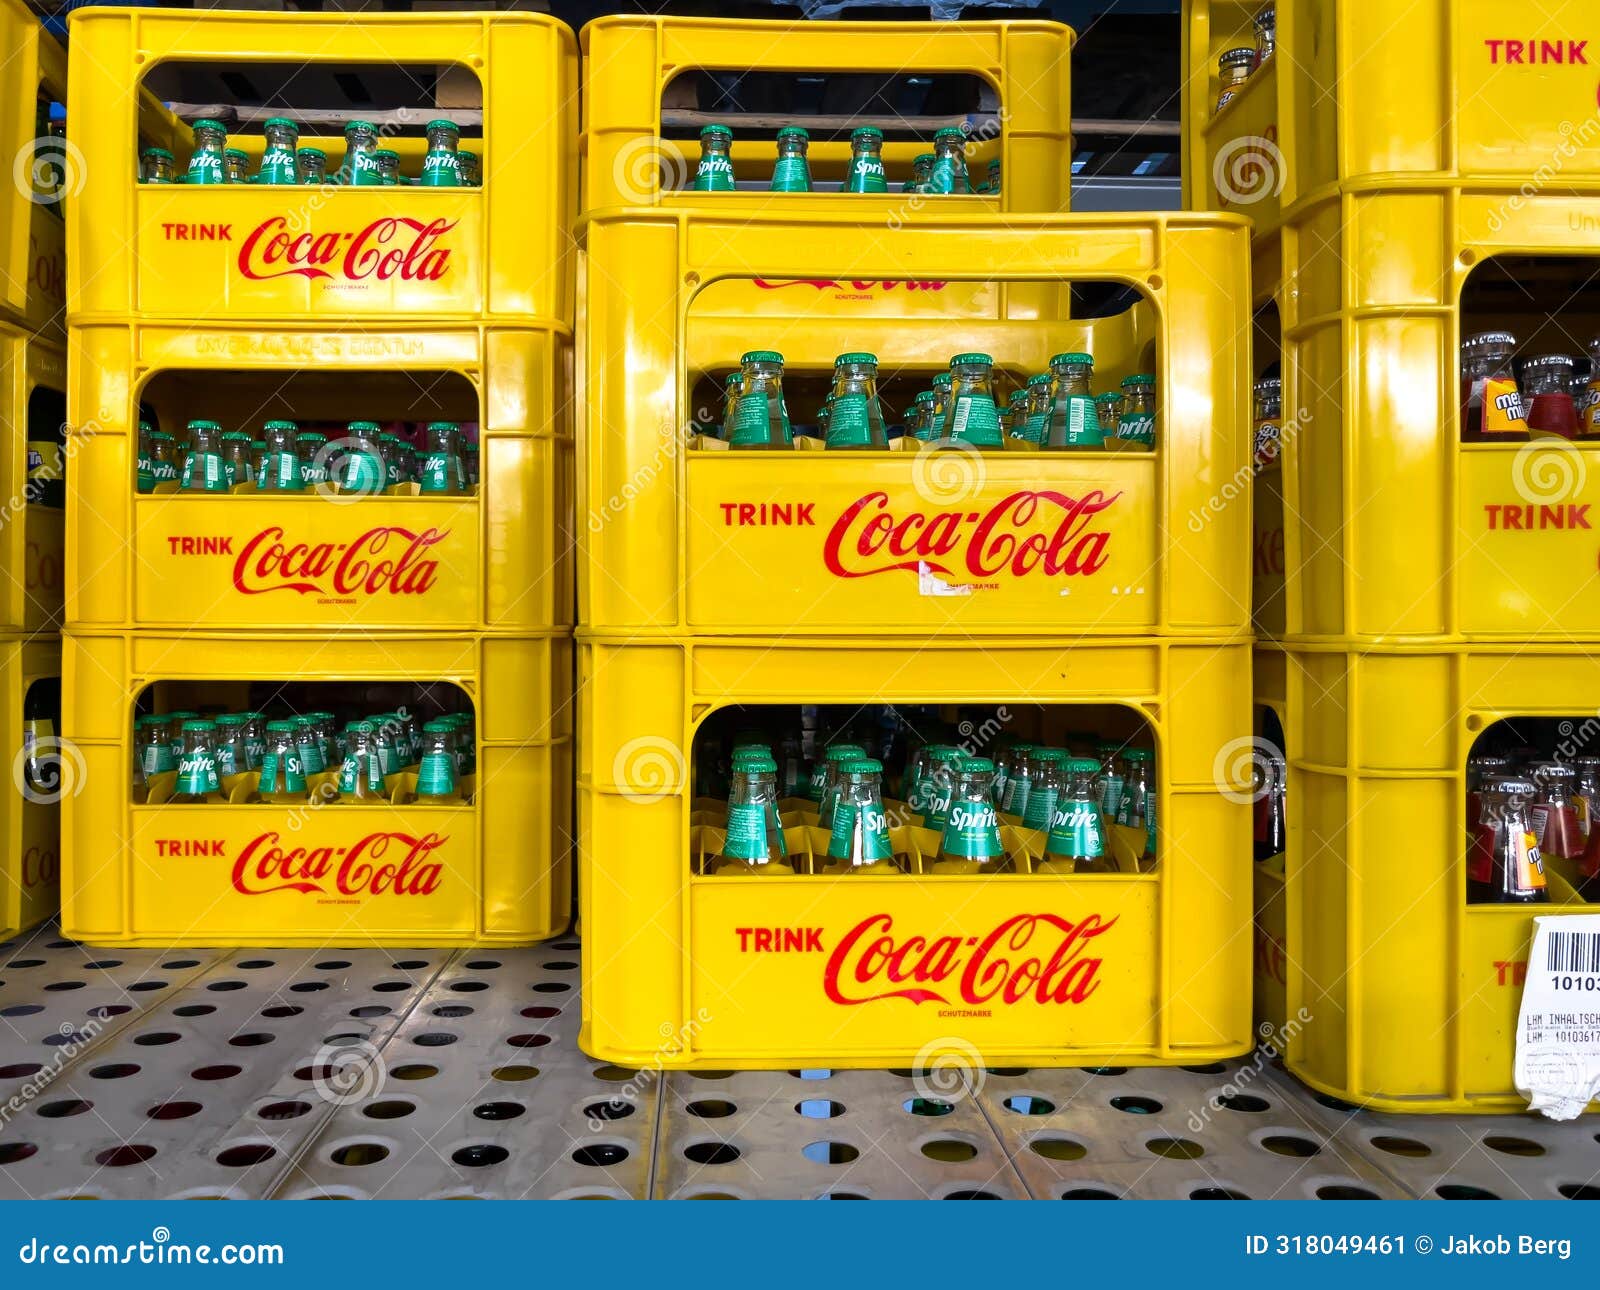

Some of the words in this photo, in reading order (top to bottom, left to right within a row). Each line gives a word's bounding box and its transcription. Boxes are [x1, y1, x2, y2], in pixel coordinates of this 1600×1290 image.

[1485, 39, 1589, 65] TRINK
[162, 224, 232, 241] TRINK
[238, 217, 461, 281] Coca-Cola
[720, 503, 815, 526] TRINK
[823, 490, 1123, 578] Coca-Cola
[1484, 503, 1592, 530] TRINK
[168, 536, 233, 556] TRINK
[233, 526, 451, 595] Coca-Cola
[950, 807, 998, 831] Sprit
[155, 839, 226, 857] TRINK
[231, 831, 450, 896] Coca-Cola
[736, 927, 825, 953] TRINK
[823, 913, 1121, 1006] Coca-Cola
